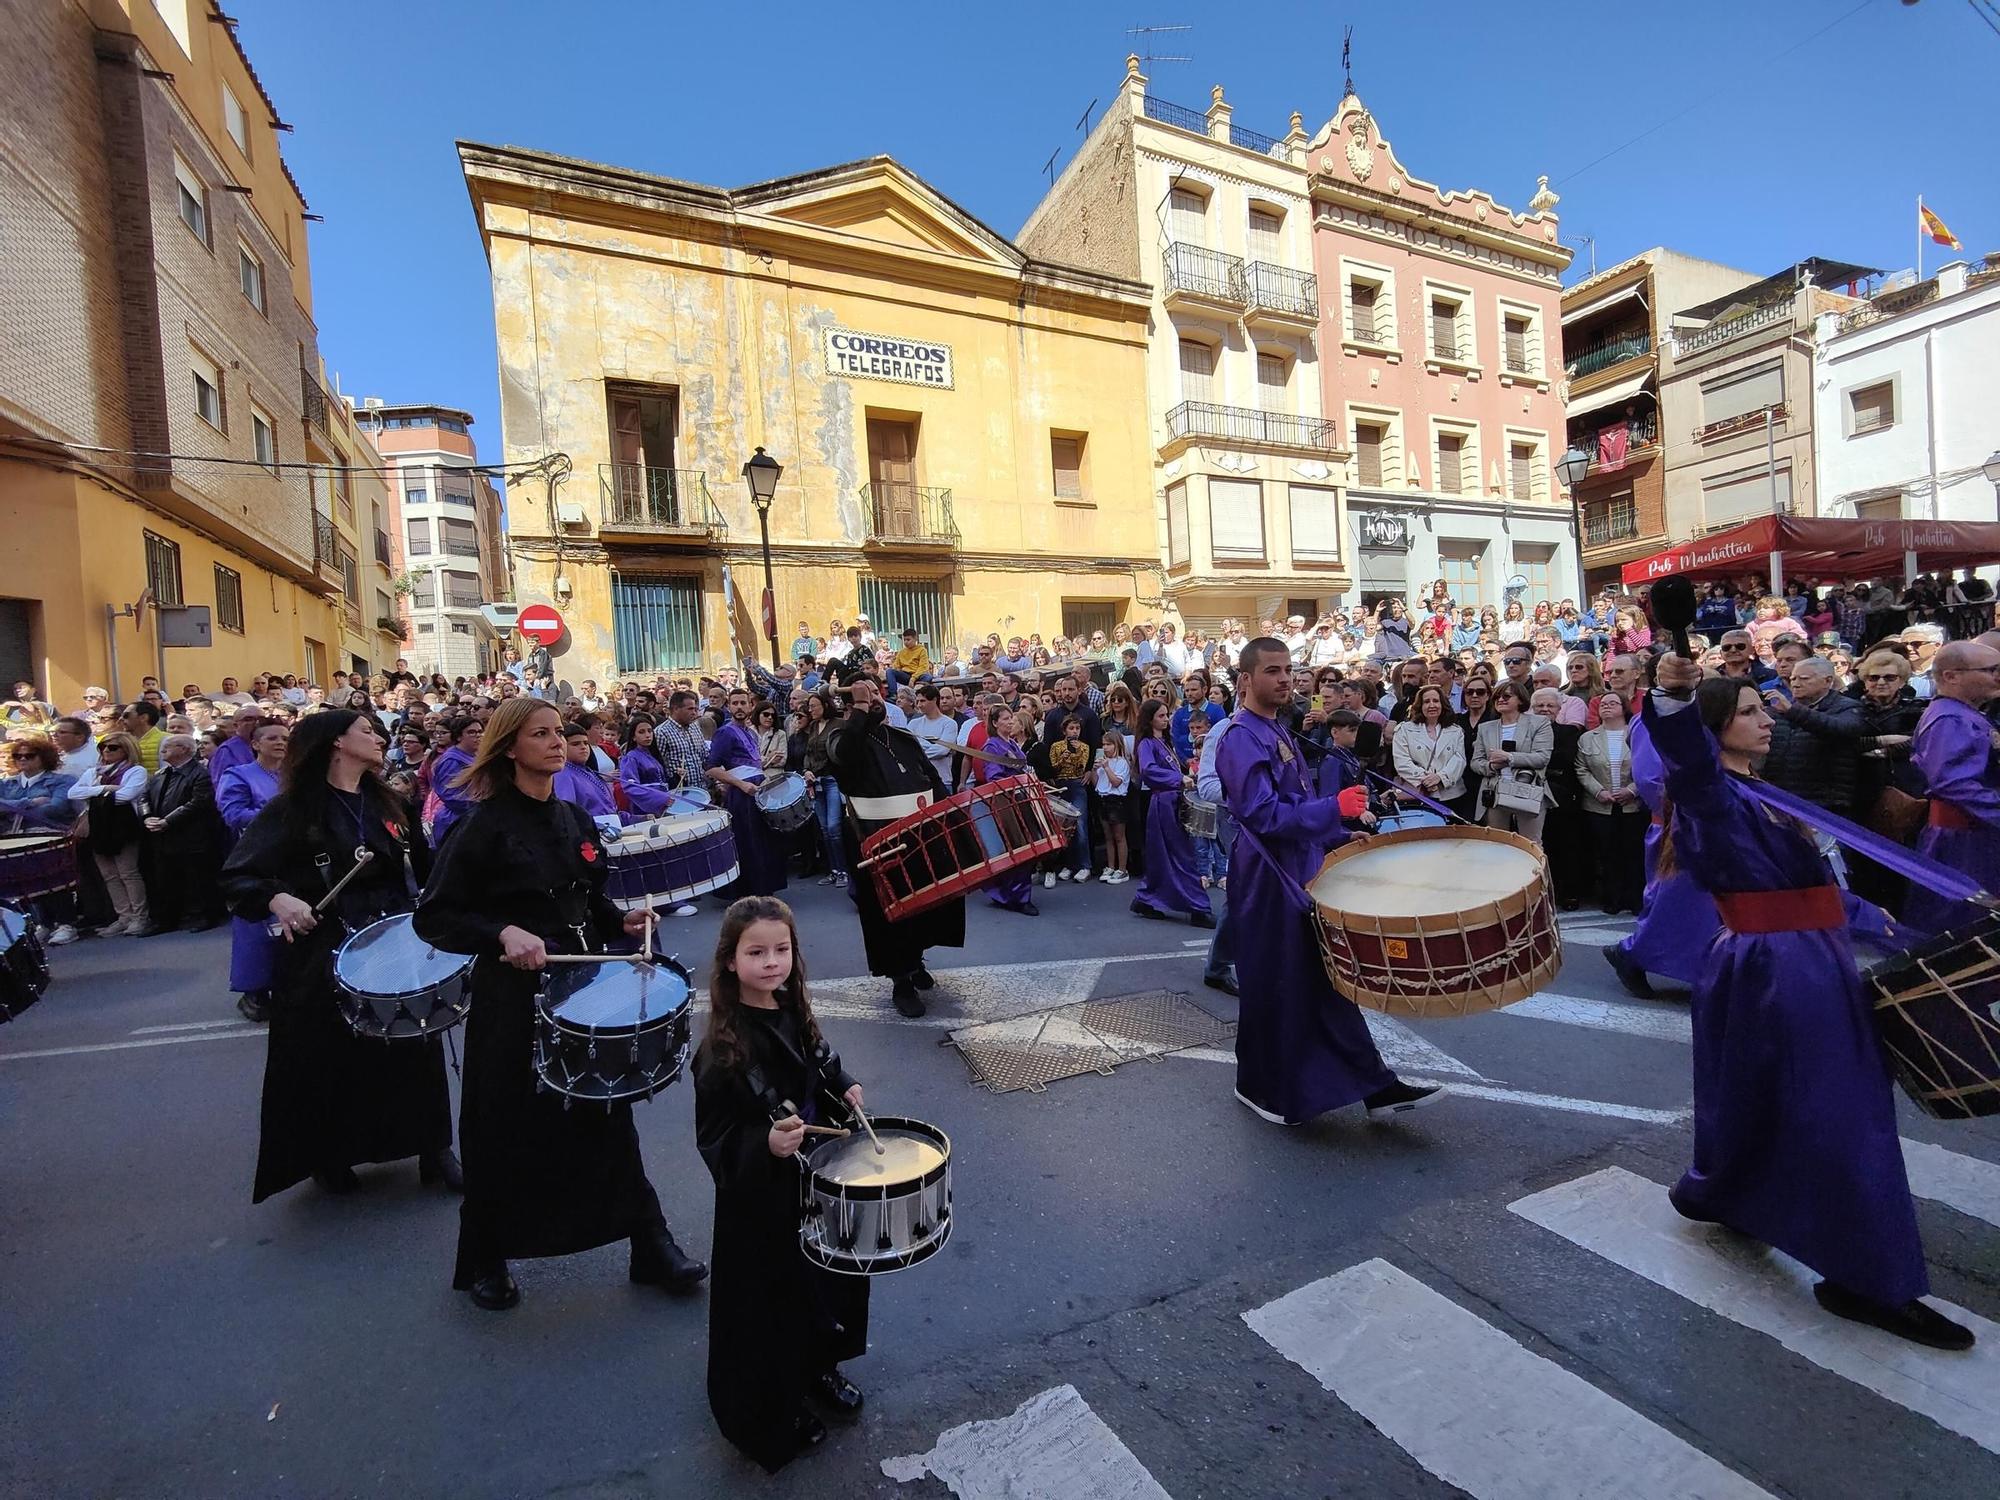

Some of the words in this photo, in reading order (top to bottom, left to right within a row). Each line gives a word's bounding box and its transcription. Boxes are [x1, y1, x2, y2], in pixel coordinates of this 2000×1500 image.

[831, 334, 946, 364] CORREOS
[837, 353, 944, 383] TELEGRAFOS
[1864, 526, 1885, 549] Pub
[1901, 526, 1955, 550] Manhattan
[1648, 557, 1674, 577] Pub
[1680, 541, 1754, 570] Manhattan
